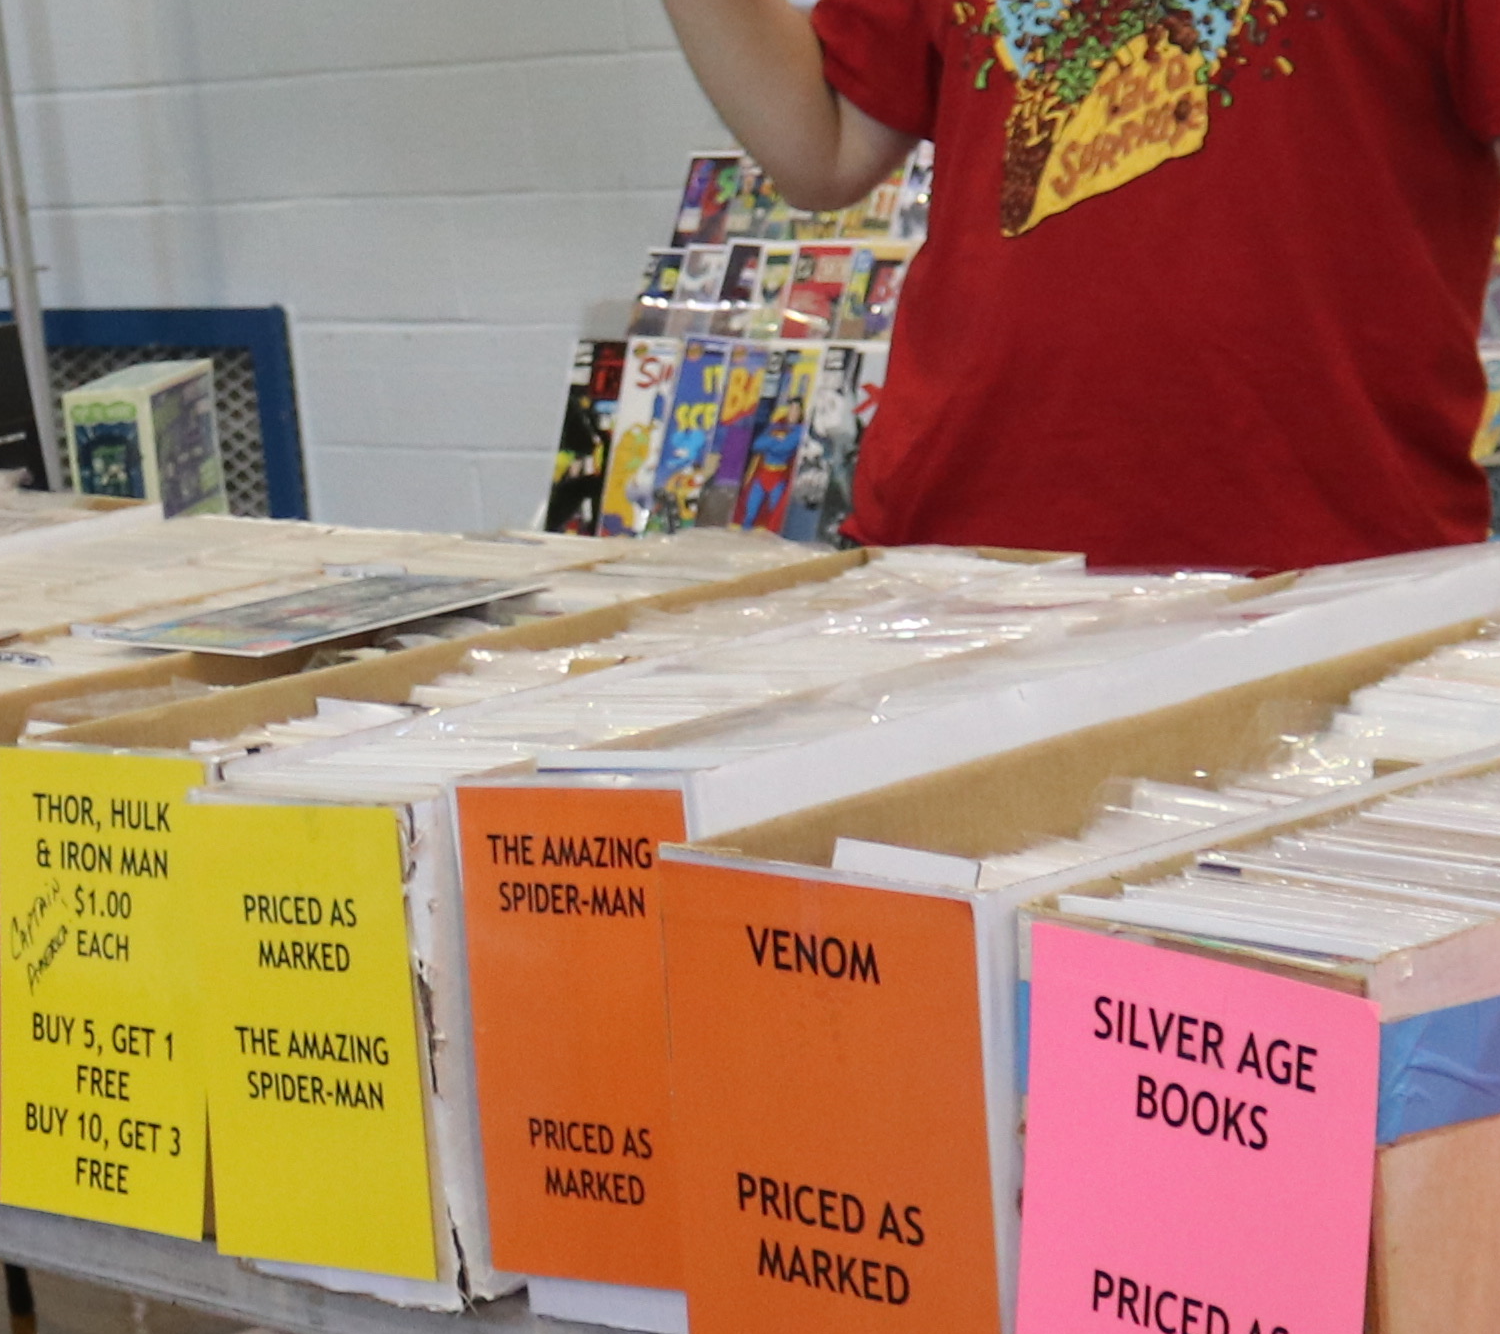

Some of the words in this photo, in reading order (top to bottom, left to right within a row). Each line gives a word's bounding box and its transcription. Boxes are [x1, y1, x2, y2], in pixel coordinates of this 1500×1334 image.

[32, 793, 103, 833] THOR,
[111, 800, 171, 832] HULK
[35, 839, 52, 867] &
[60, 840, 113, 876] IRON
[120, 848, 169, 879] MAN
[486, 834, 534, 866] THE
[541, 836, 653, 870] AMAZING
[74, 885, 132, 920] $1.00
[242, 894, 321, 927] PRICED
[329, 897, 357, 928] AS
[499, 881, 646, 918] SPIDER-MAN
[77, 929, 129, 961] EACH
[258, 939, 350, 973] MARKED
[746, 924, 881, 985] VENOM
[32, 1012, 75, 1046] BUY
[84, 1019, 104, 1056] 5,
[111, 1024, 155, 1058] GET
[165, 1032, 174, 1061] 1
[234, 1026, 280, 1057] THE
[287, 1030, 389, 1067] AMAZING
[1092, 995, 1224, 1071] SILVER
[1236, 1034, 1319, 1095] AGE
[76, 1065, 130, 1101] FREE
[246, 1071, 385, 1111] SPIDER-MAN
[25, 1103, 68, 1136] BUY
[77, 1112, 109, 1150] 10,
[118, 1119, 162, 1153] GET
[169, 1127, 181, 1157] 3
[1135, 1075, 1270, 1152] BOOKS
[528, 1117, 614, 1156] PRICED
[622, 1127, 653, 1160] AS
[75, 1156, 129, 1194] FREE
[545, 1166, 646, 1206] MARKED
[736, 1172, 866, 1235] PRICED
[877, 1201, 926, 1247] AS
[758, 1238, 911, 1306] MARKED
